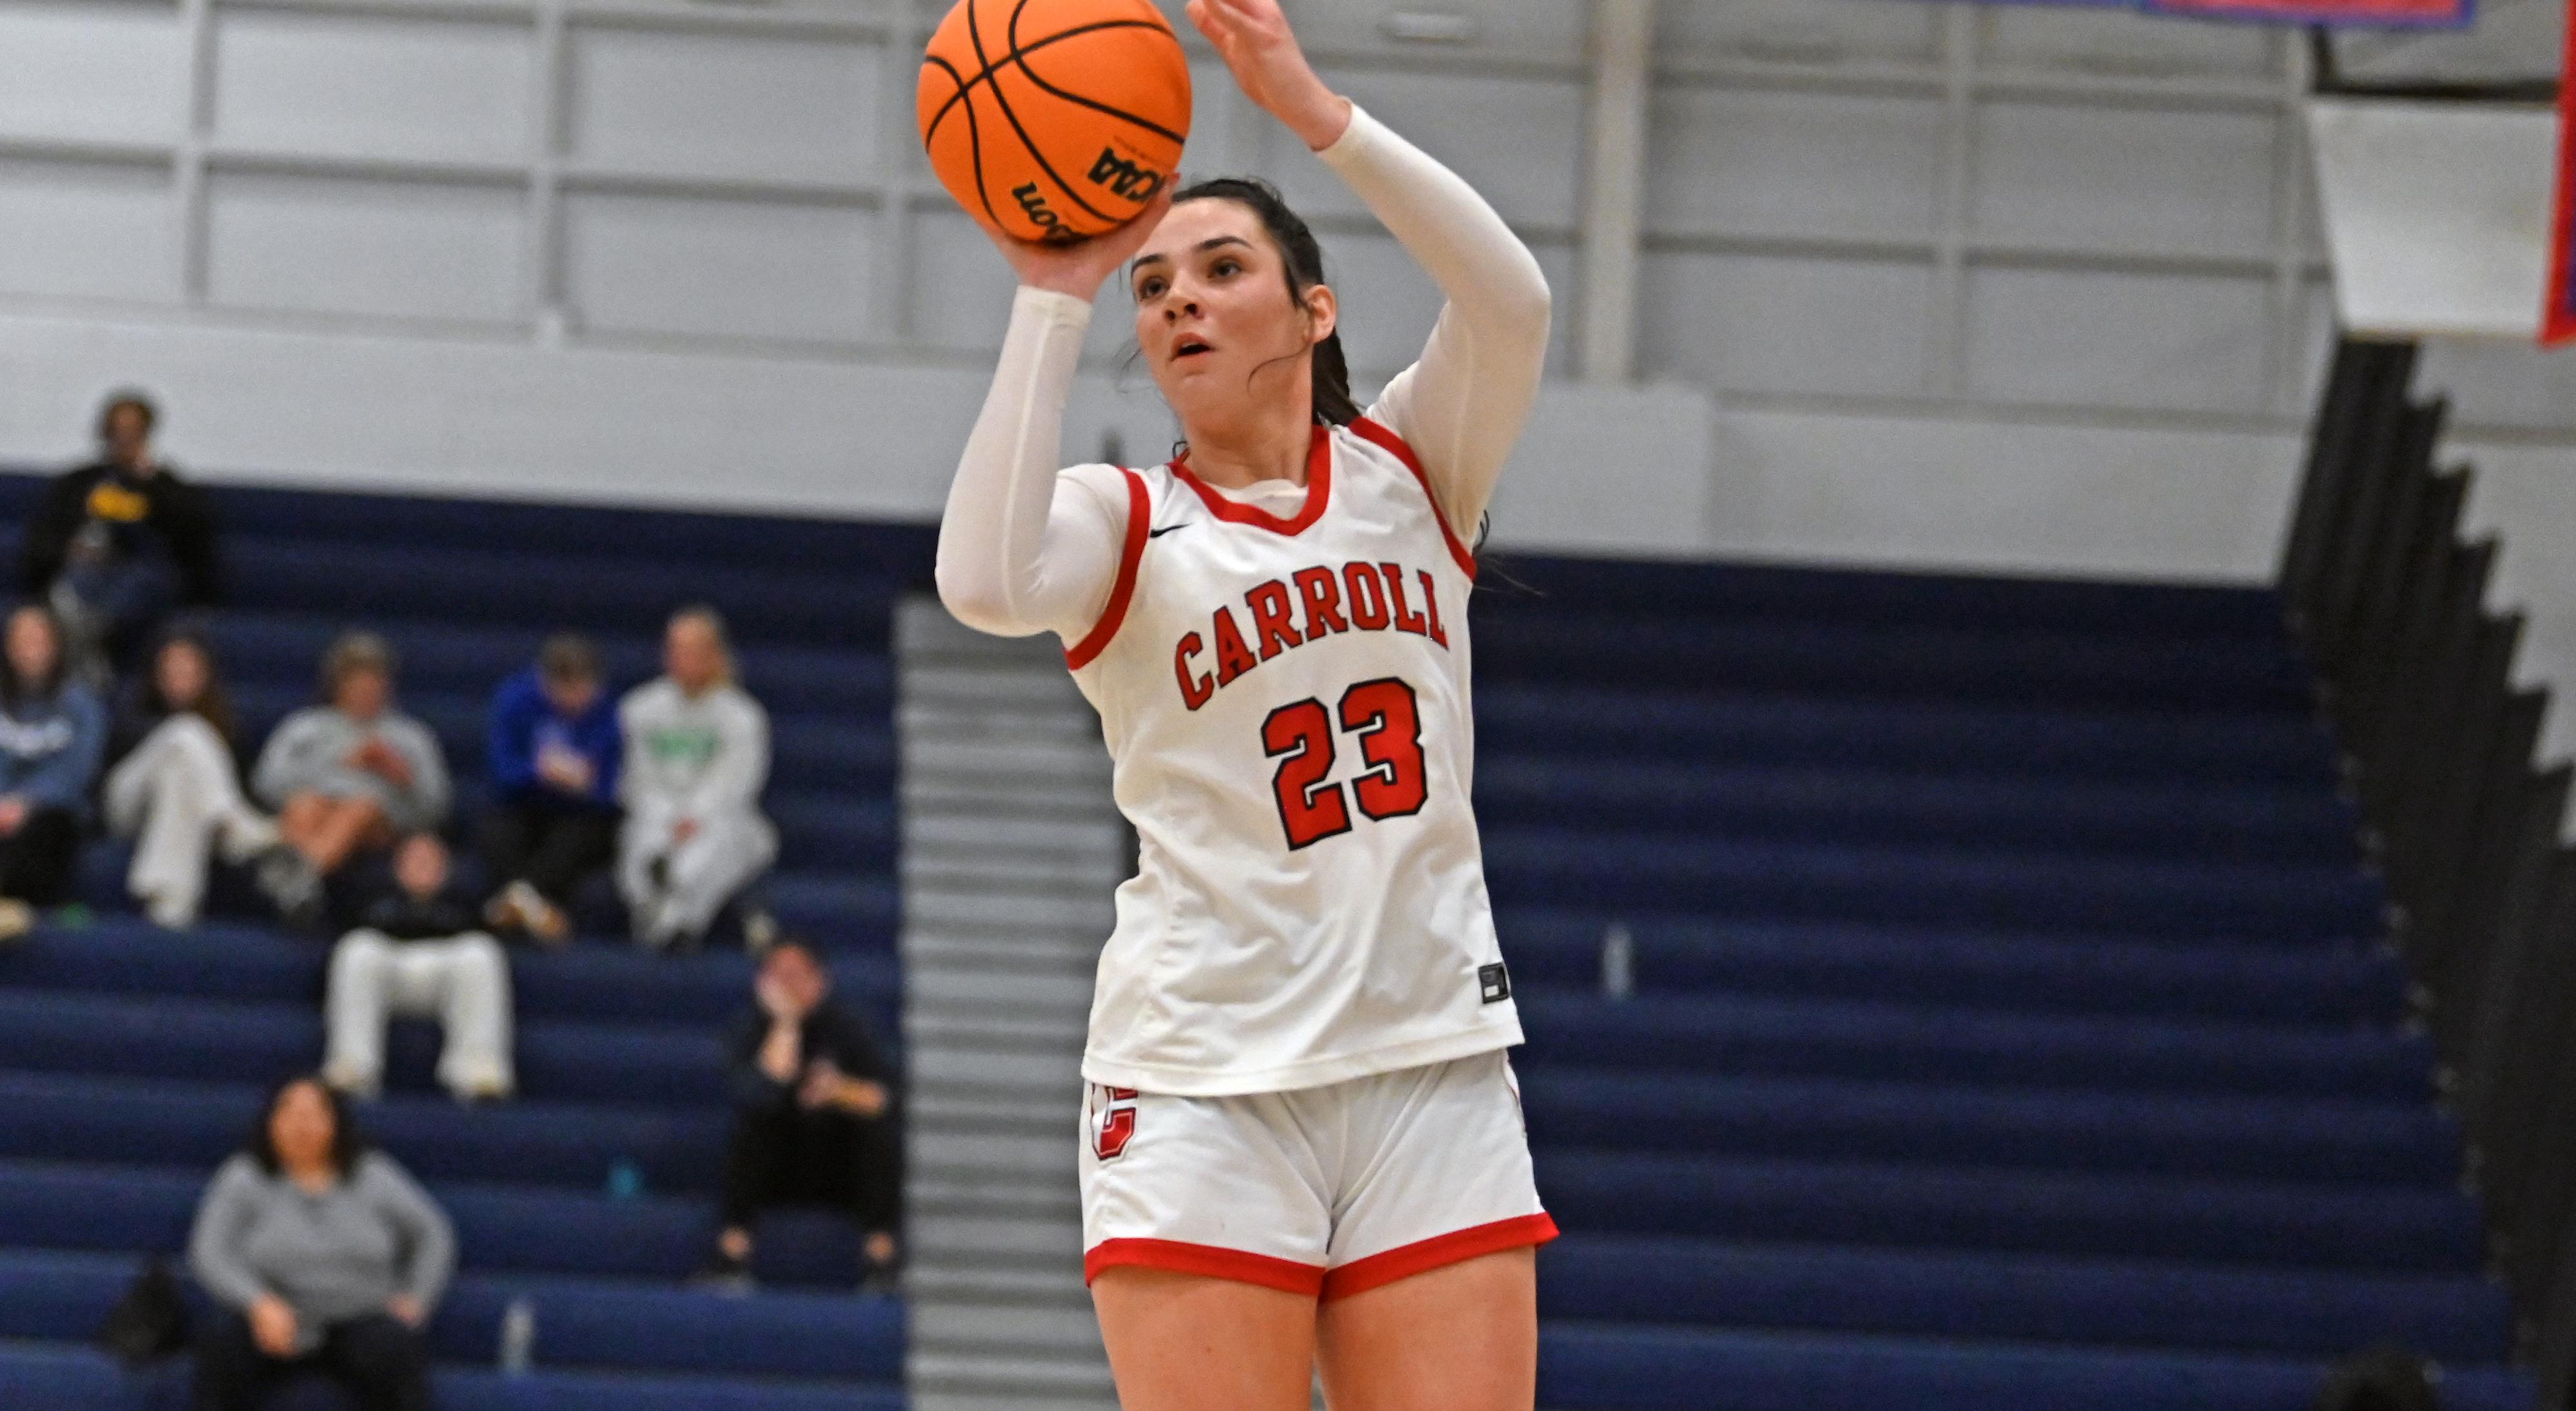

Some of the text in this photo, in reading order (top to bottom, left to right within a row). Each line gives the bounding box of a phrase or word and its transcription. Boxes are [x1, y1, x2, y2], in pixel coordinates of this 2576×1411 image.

[1087, 146, 1165, 203] CAA
[1174, 562, 1449, 711] CARROLL
[1261, 676, 1429, 851] 23
